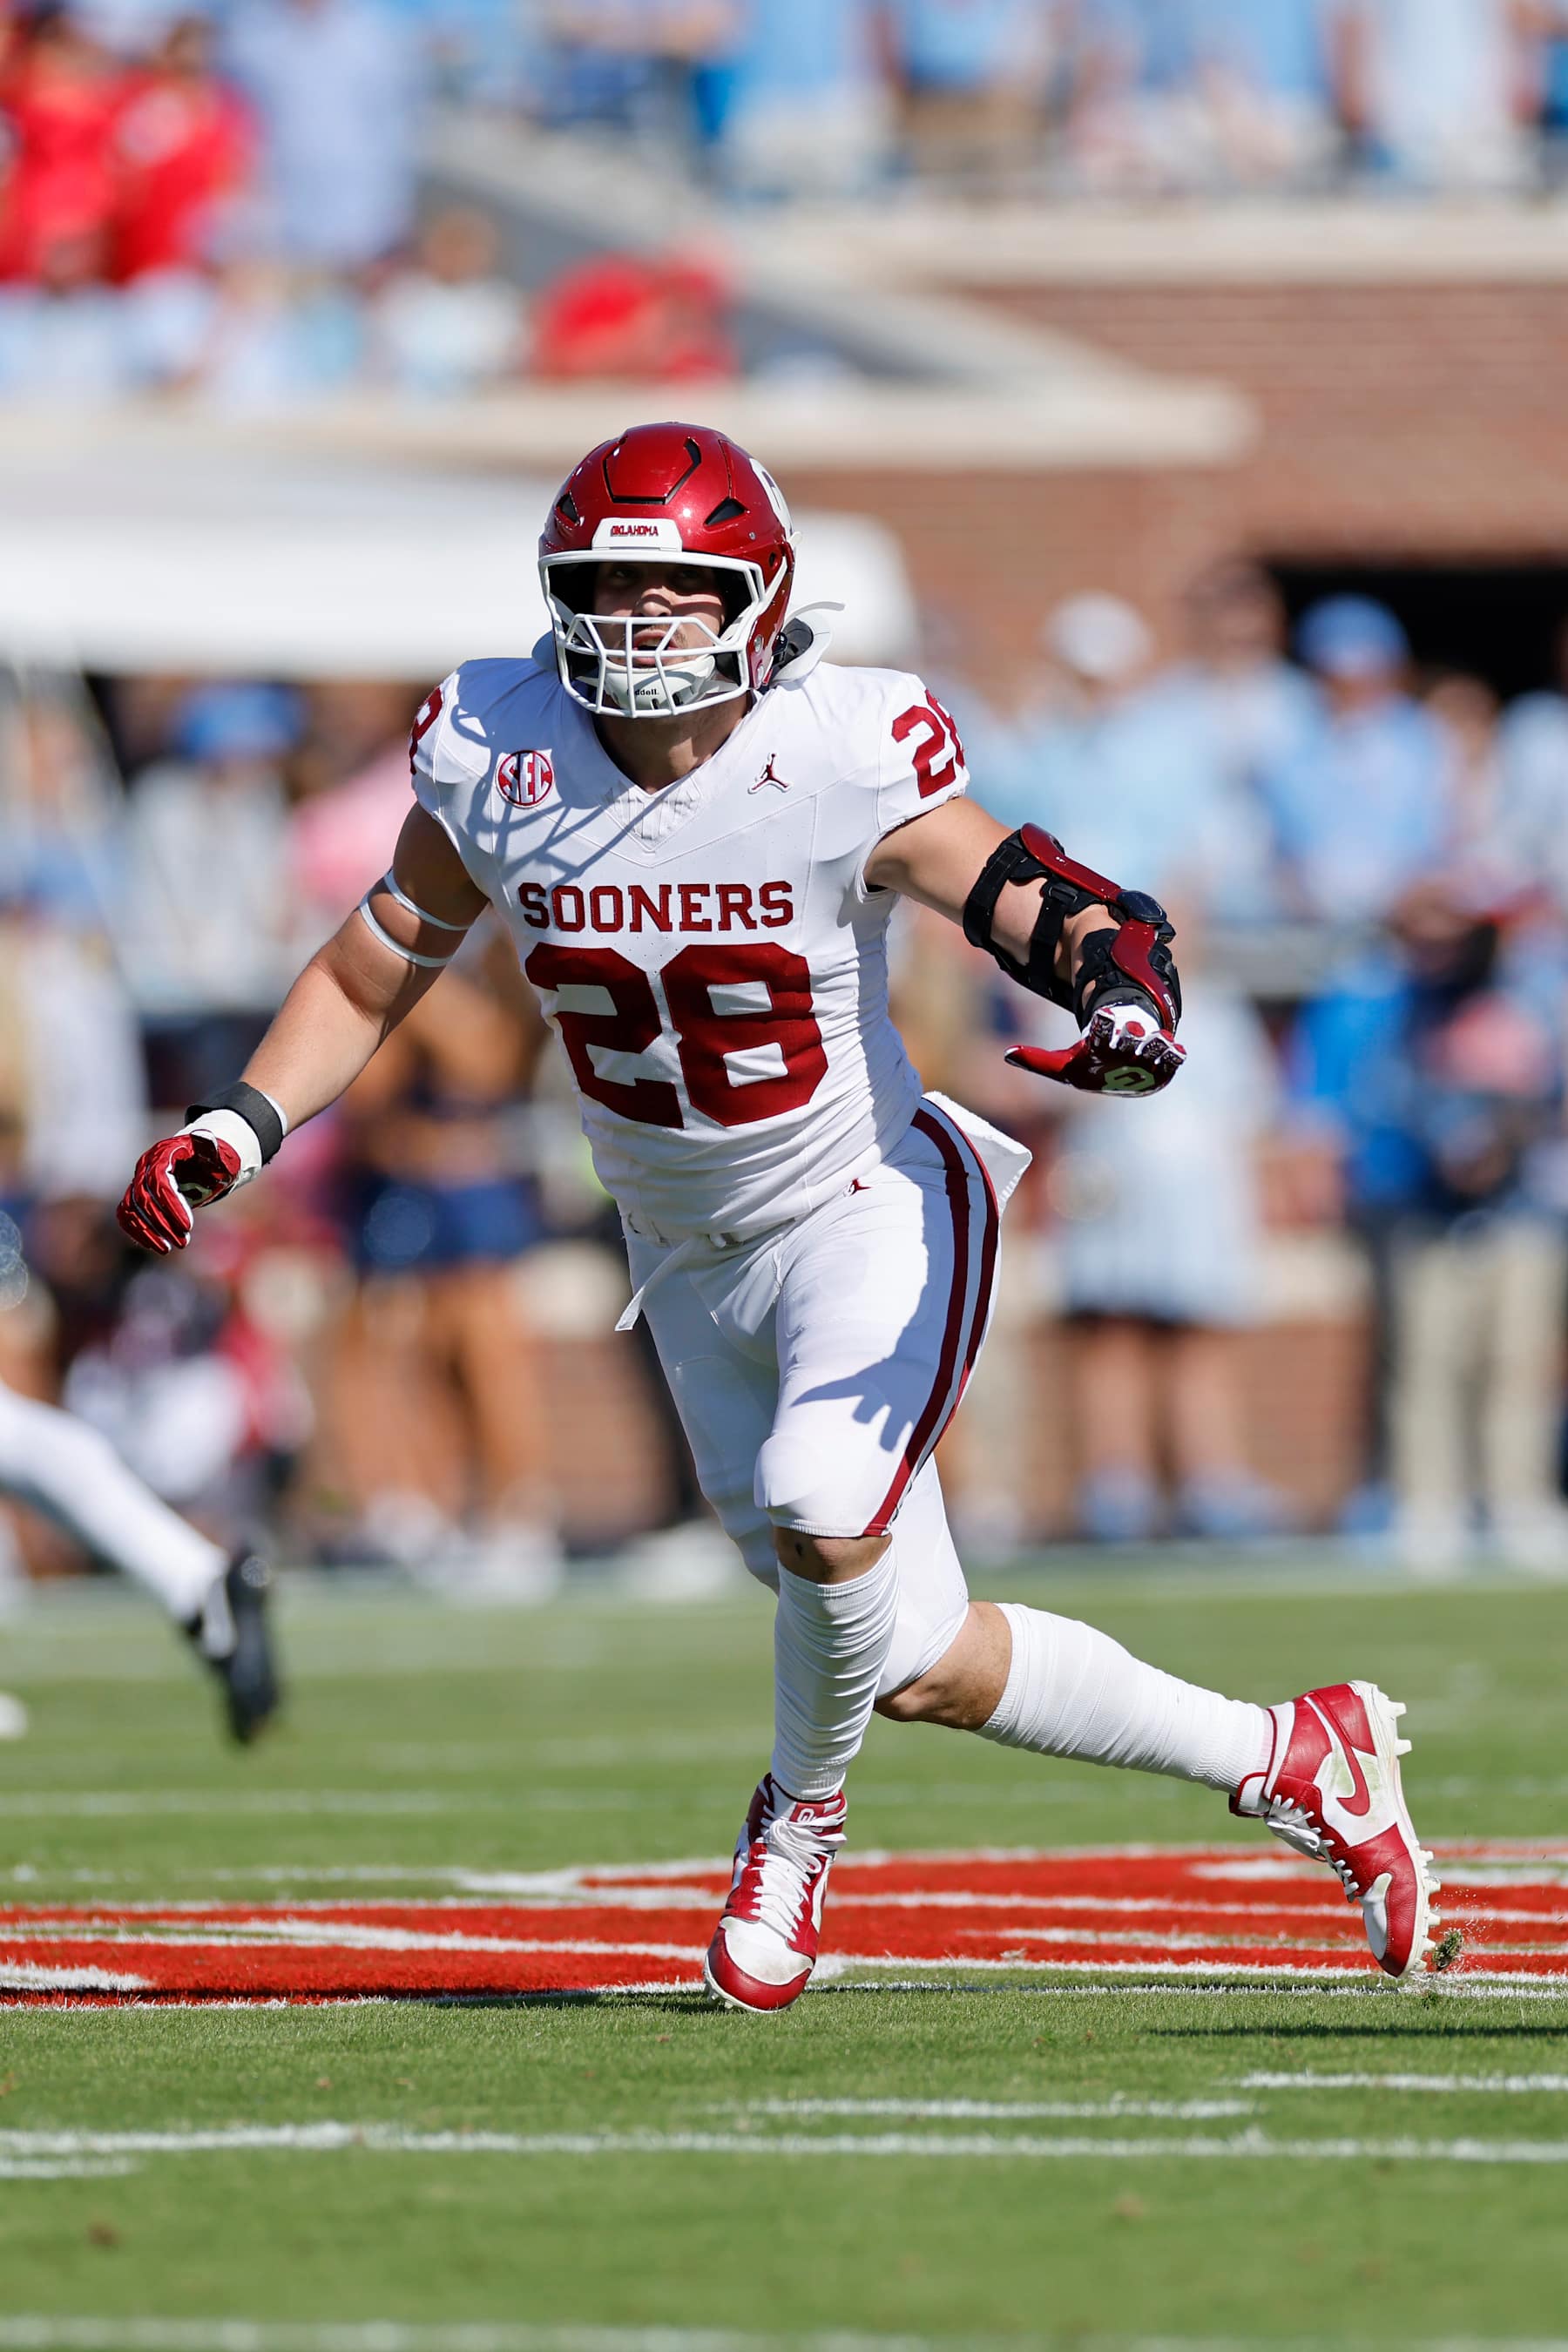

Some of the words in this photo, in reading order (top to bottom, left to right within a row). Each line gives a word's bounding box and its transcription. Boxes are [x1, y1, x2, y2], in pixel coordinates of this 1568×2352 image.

[610, 525, 659, 537] OKLAHOMA
[497, 751, 553, 806] SEC
[518, 881, 794, 932] SOONERS
[524, 942, 828, 1129] 28
